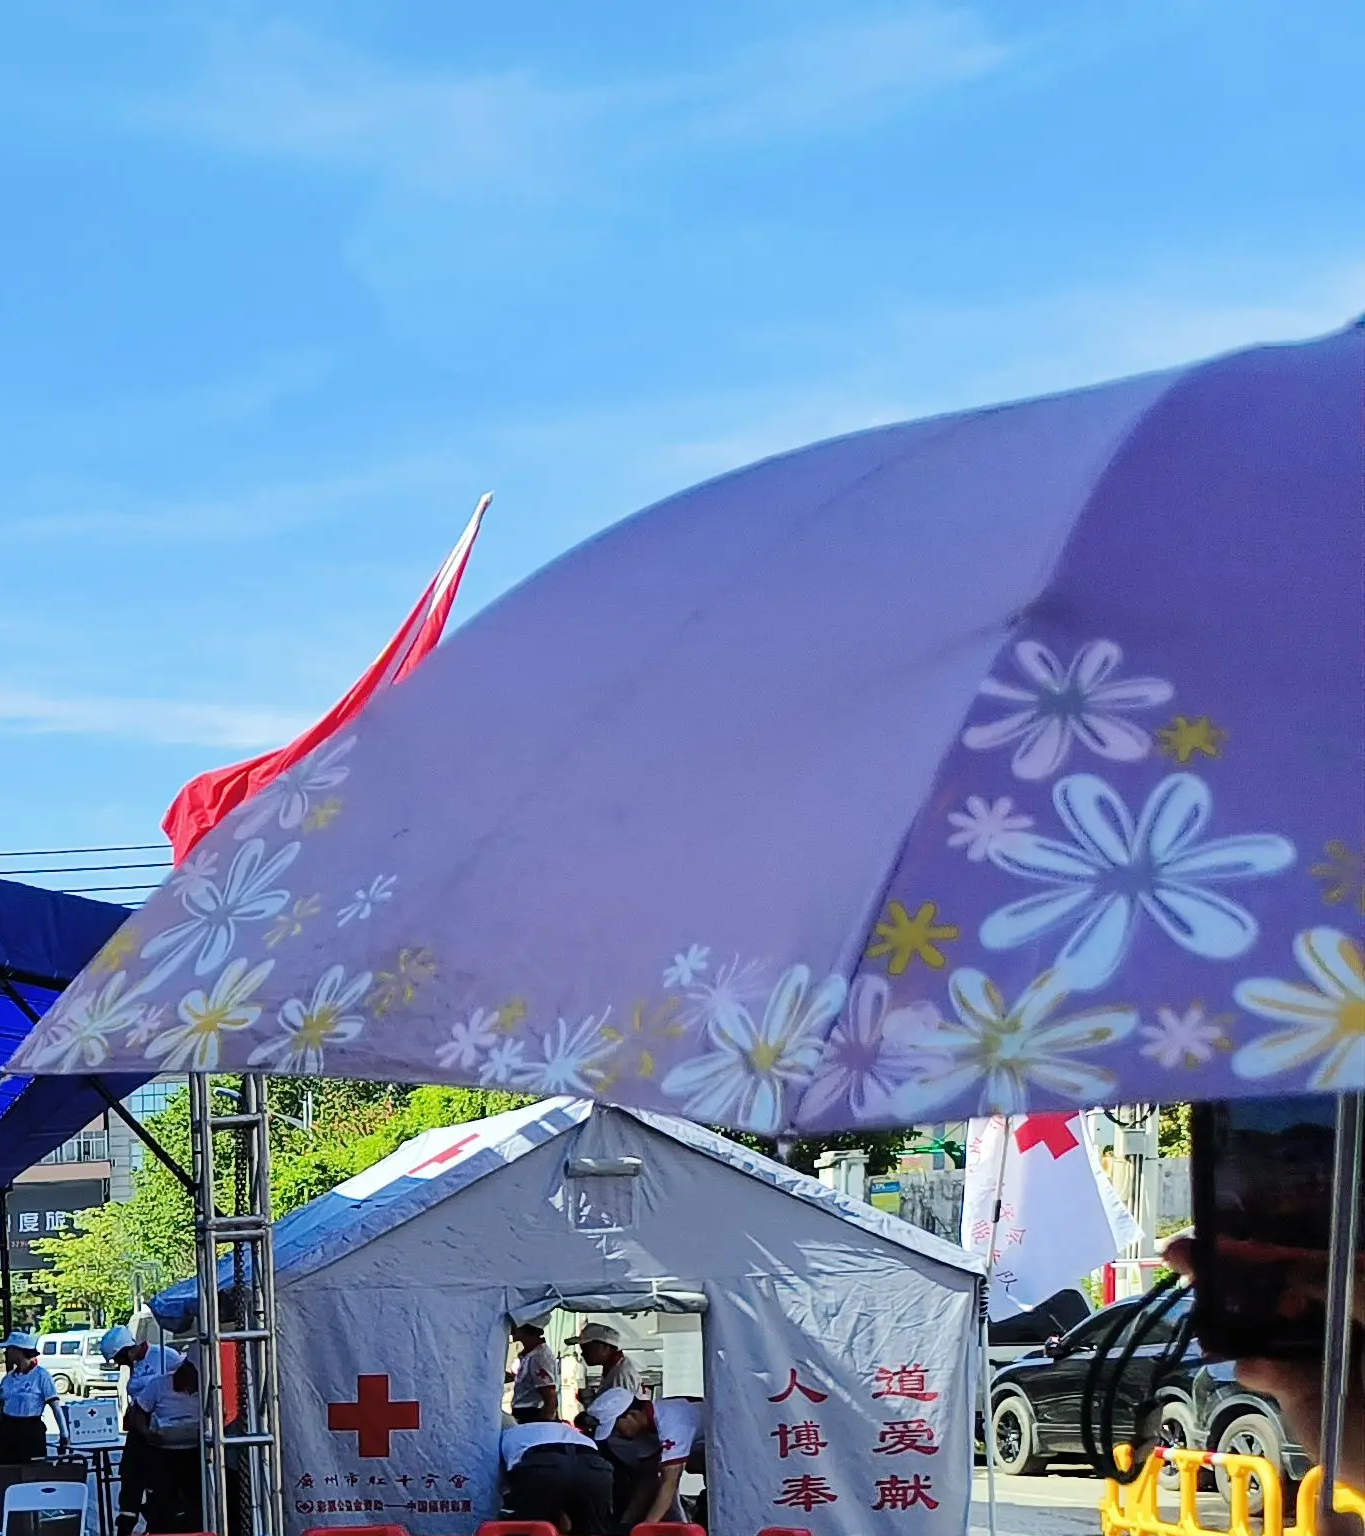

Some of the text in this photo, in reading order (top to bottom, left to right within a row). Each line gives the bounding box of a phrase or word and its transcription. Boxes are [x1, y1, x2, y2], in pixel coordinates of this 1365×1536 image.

[766, 1363, 939, 1403] 人道
[770, 1418, 940, 1459] 博爱
[772, 1473, 940, 1512] 奉献
